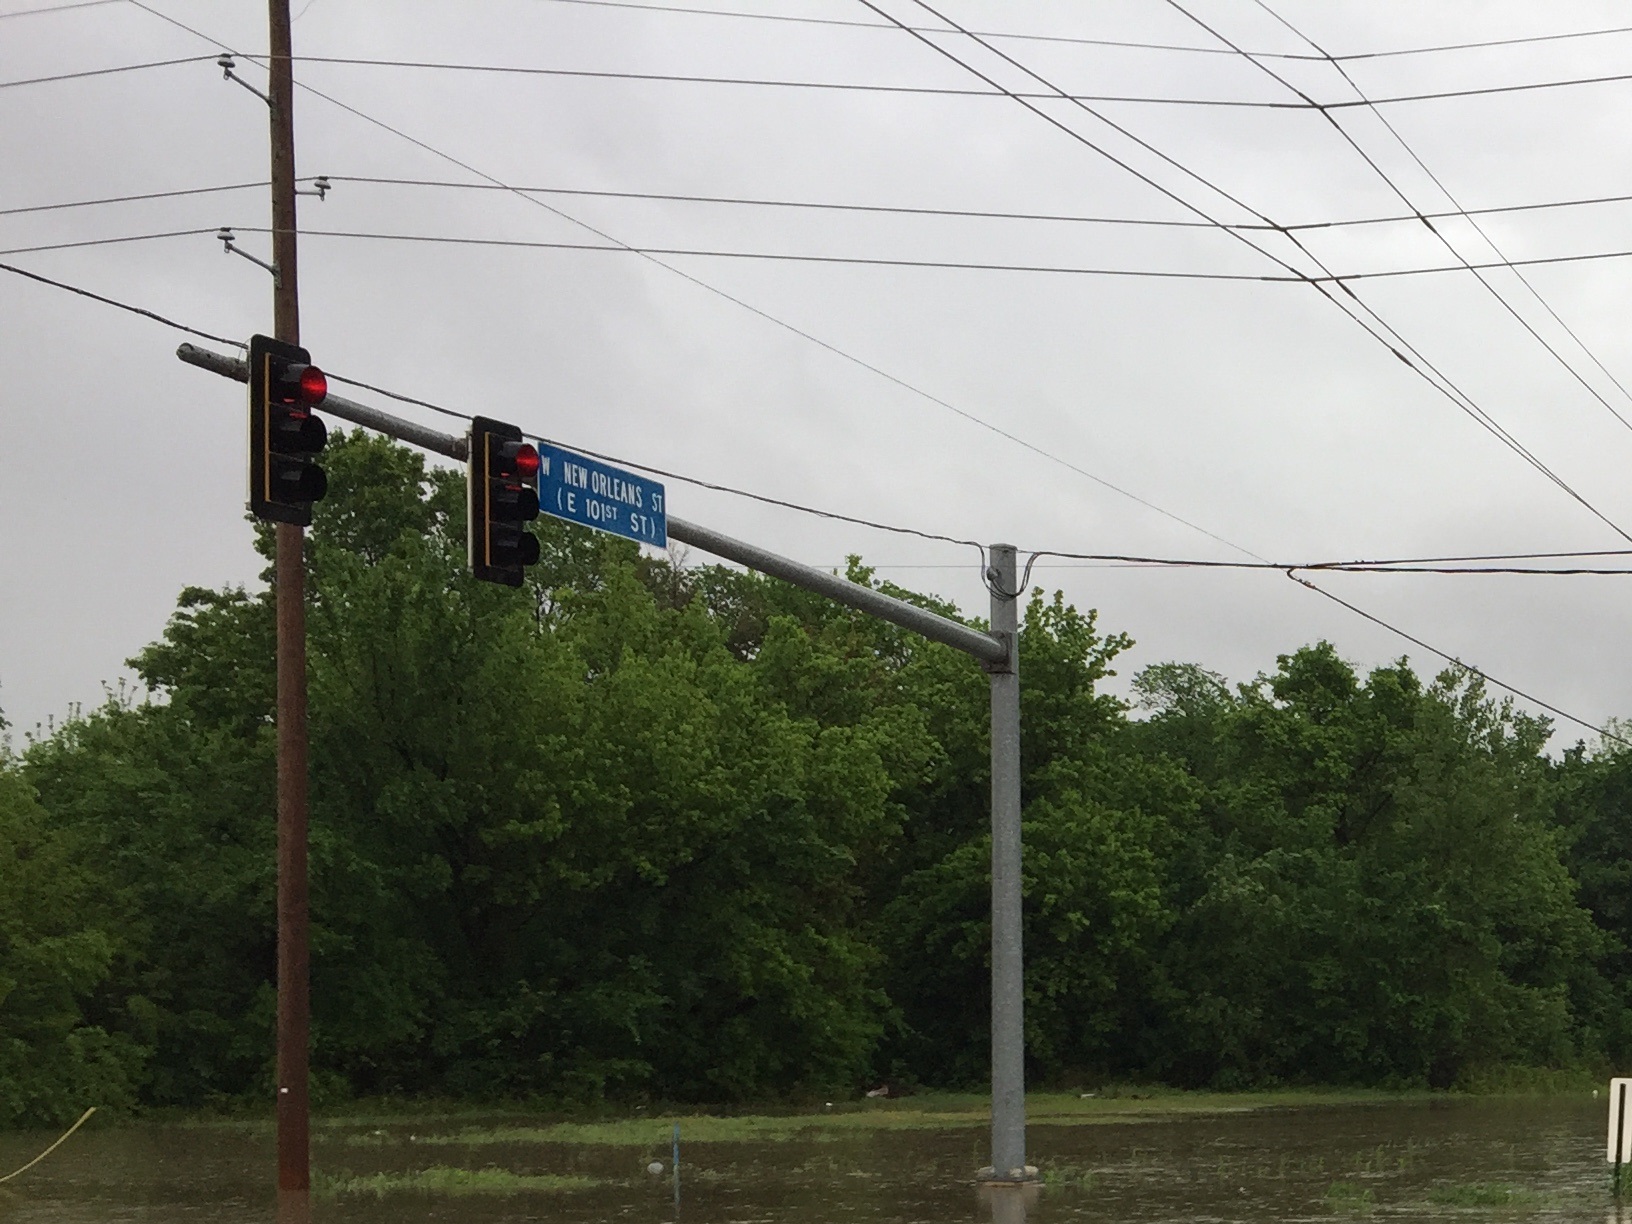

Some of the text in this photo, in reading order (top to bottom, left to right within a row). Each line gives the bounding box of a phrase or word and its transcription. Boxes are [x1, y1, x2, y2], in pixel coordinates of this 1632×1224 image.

[542, 456, 663, 513] W NEW ORLEANS ST
[630, 512, 656, 539] ST)
